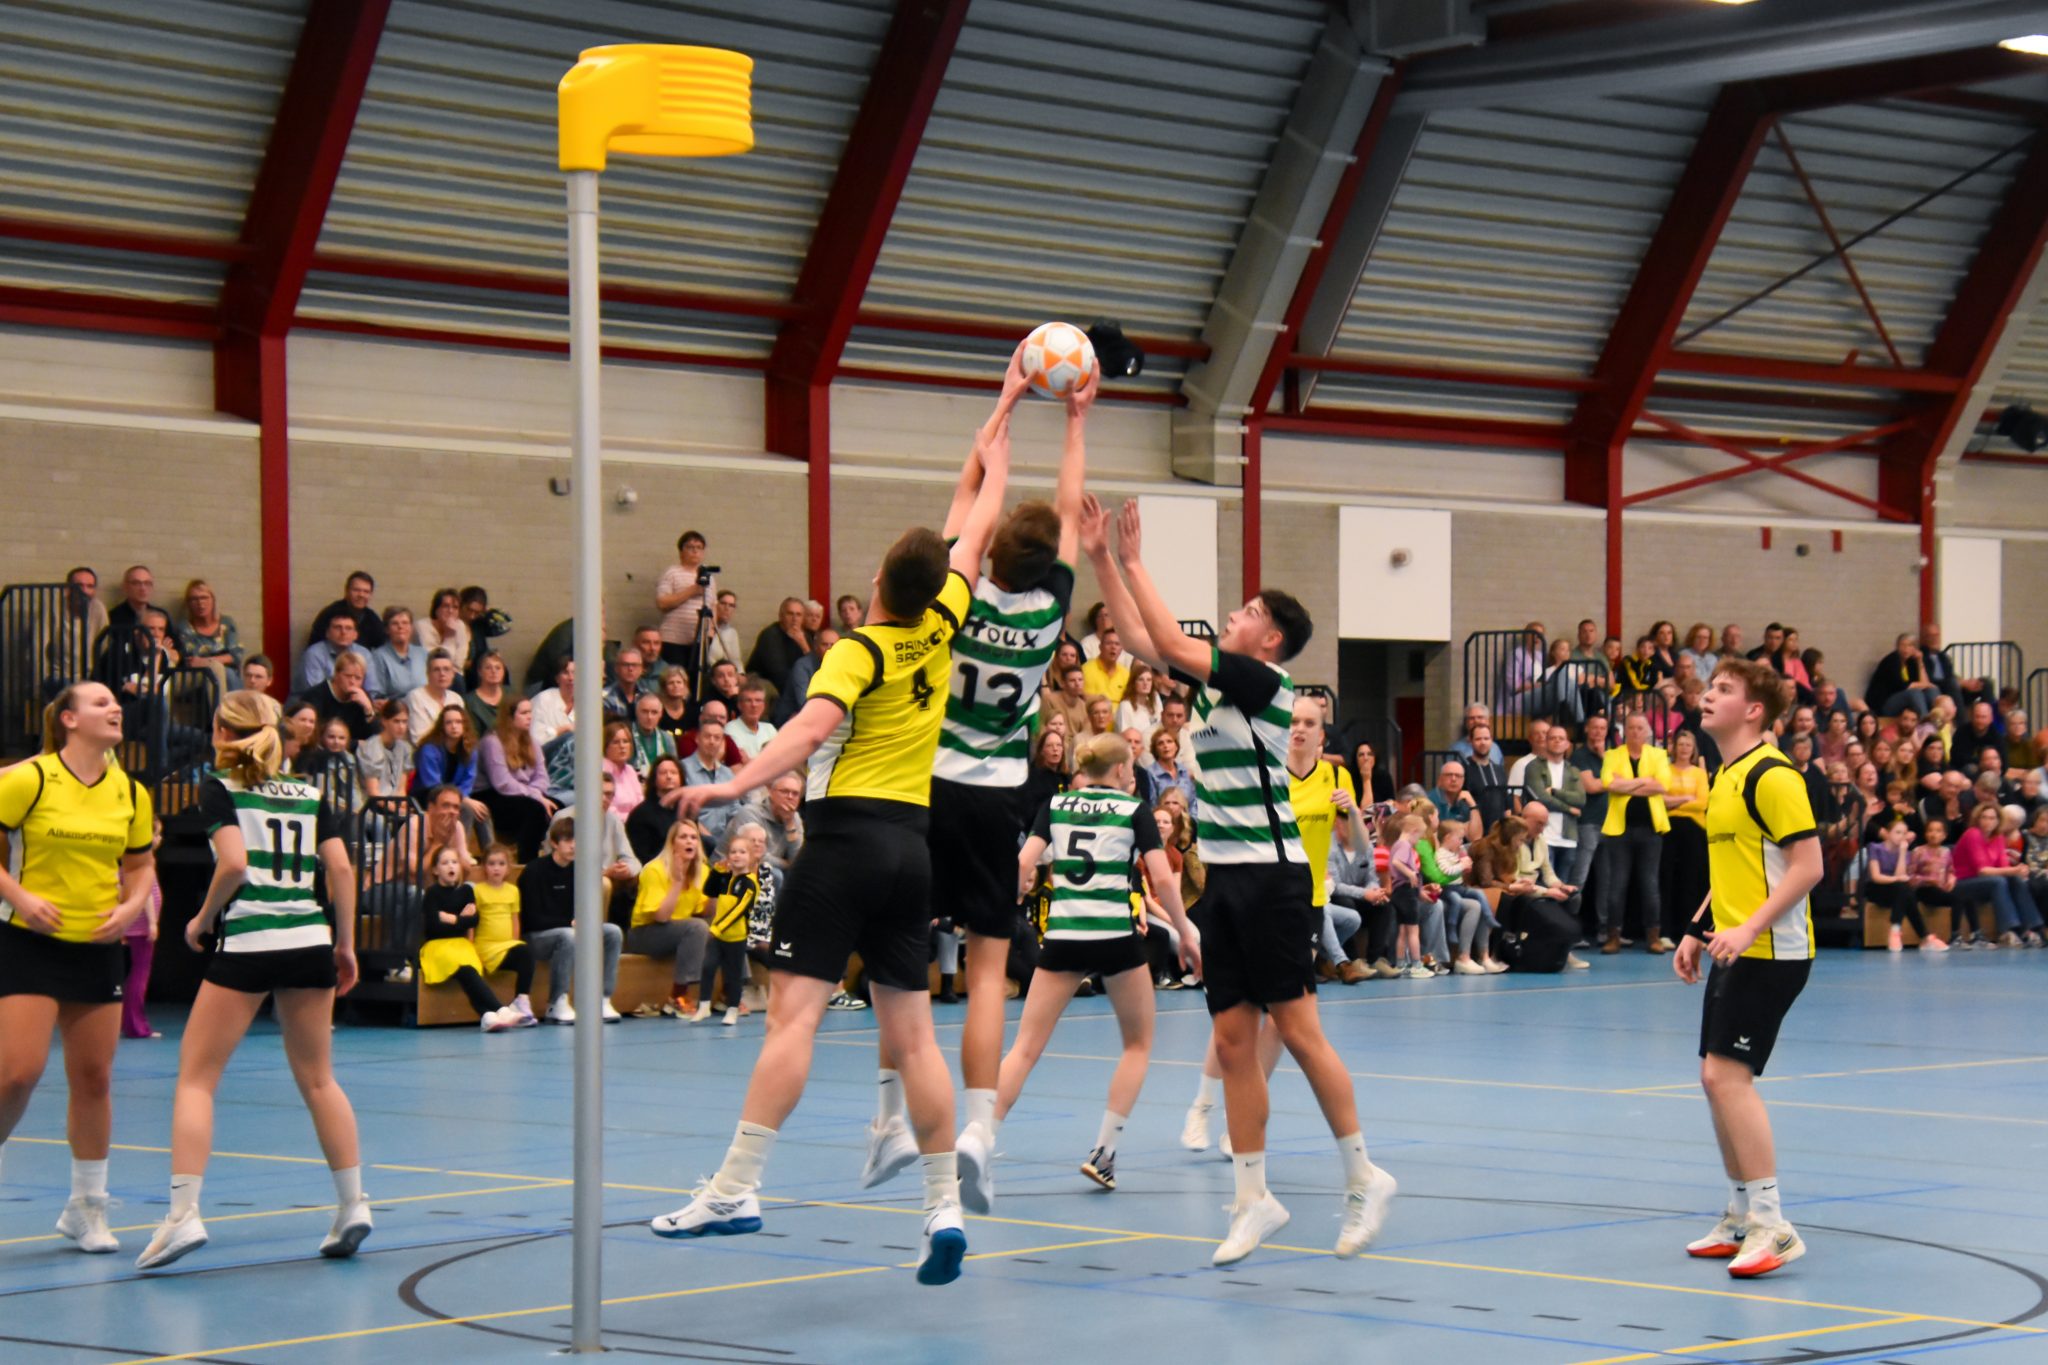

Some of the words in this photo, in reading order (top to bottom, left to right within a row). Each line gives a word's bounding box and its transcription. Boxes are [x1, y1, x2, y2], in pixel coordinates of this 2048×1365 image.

[911, 665, 935, 712] 4
[266, 818, 303, 882] 11
[1064, 830, 1097, 886] 5
